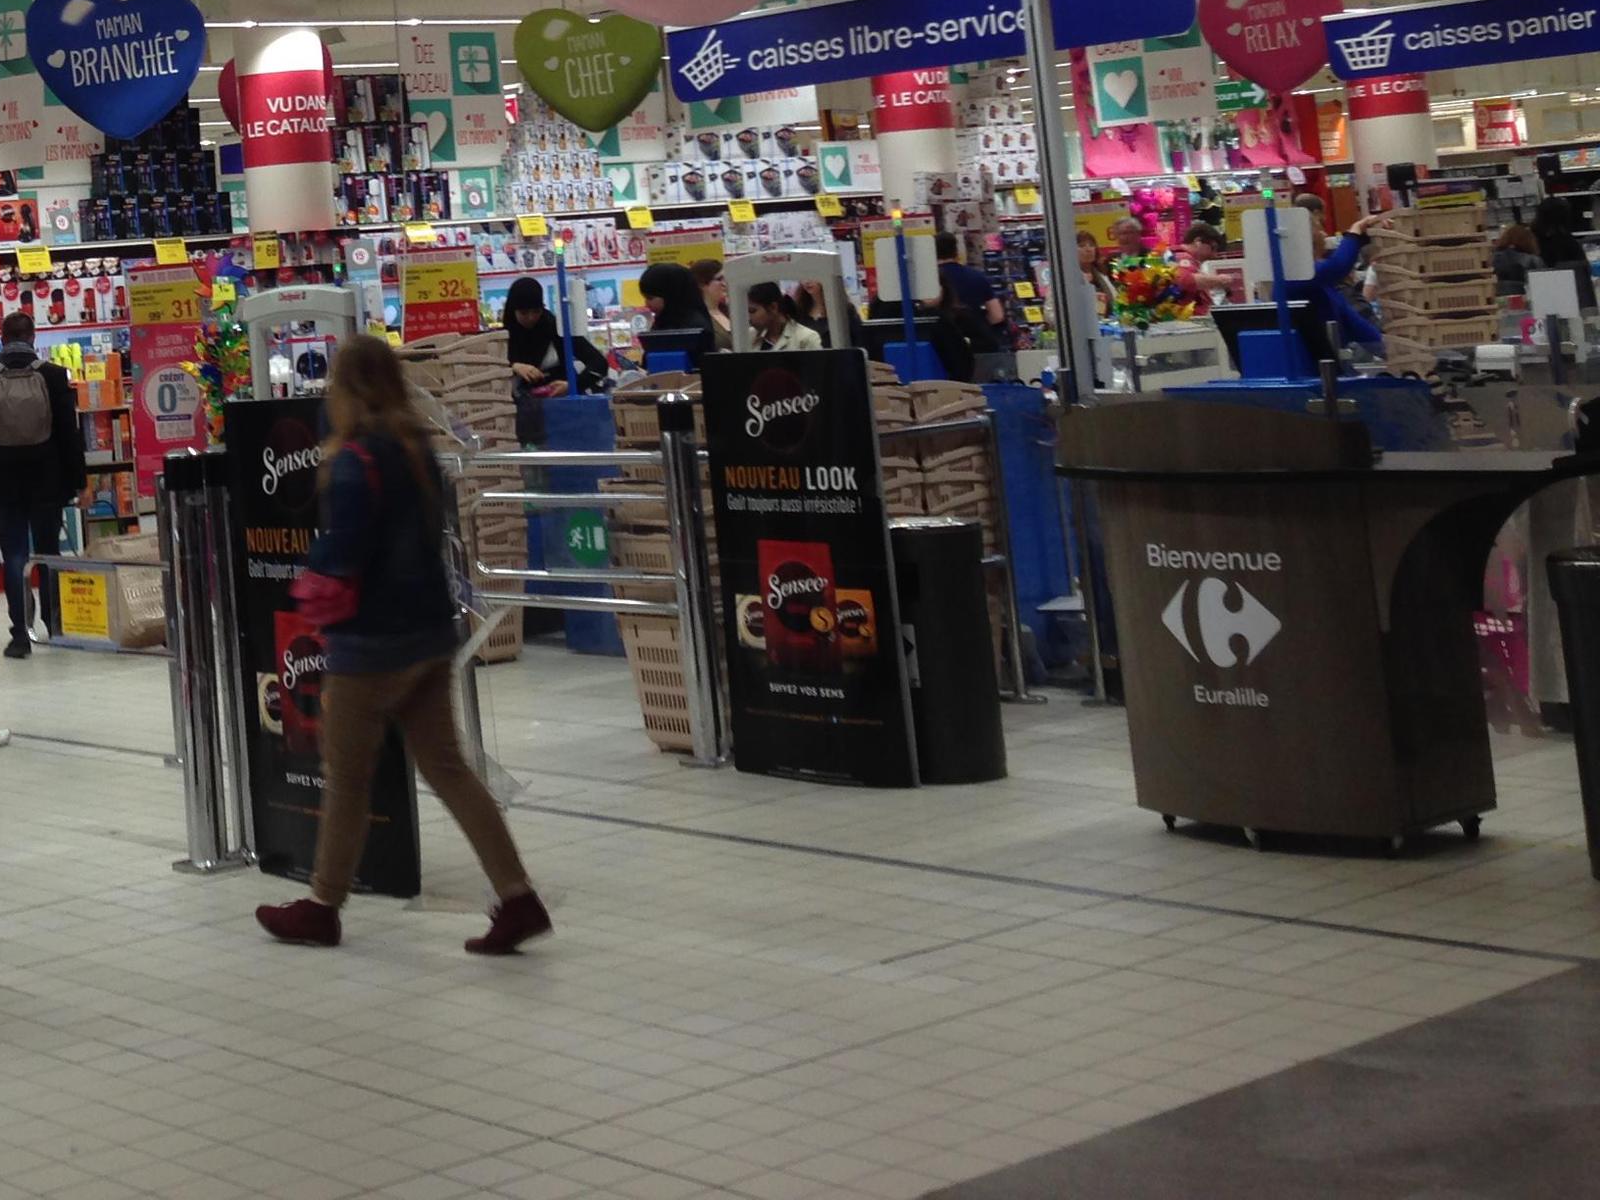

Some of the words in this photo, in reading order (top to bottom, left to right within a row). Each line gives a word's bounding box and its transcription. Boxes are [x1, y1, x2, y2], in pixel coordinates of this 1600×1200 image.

[95, 12, 143, 40] MAMAN
[747, 39, 844, 71] caisses
[849, 5, 1026, 55] libre-service
[1244, 20, 1302, 54] RELAX
[1404, 23, 1503, 51] caisses
[1506, 7, 1597, 45] panier
[70, 32, 179, 87] BRANCHÉE
[564, 53, 616, 98] CHEF
[1371, 81, 1390, 95] LE
[266, 96, 293, 113] VU
[892, 93, 911, 106] LE
[247, 121, 265, 138] LE
[266, 117, 329, 136] CATALO
[725, 466, 800, 489] NOUVEAU
[805, 466, 859, 491] LOOK
[804, 494, 857, 514] irrésistible
[246, 528, 310, 554] NOUVEAU
[1146, 543, 1282, 572] Bienvenue
[820, 687, 845, 699] SENS
[1194, 685, 1269, 709] Euralille
